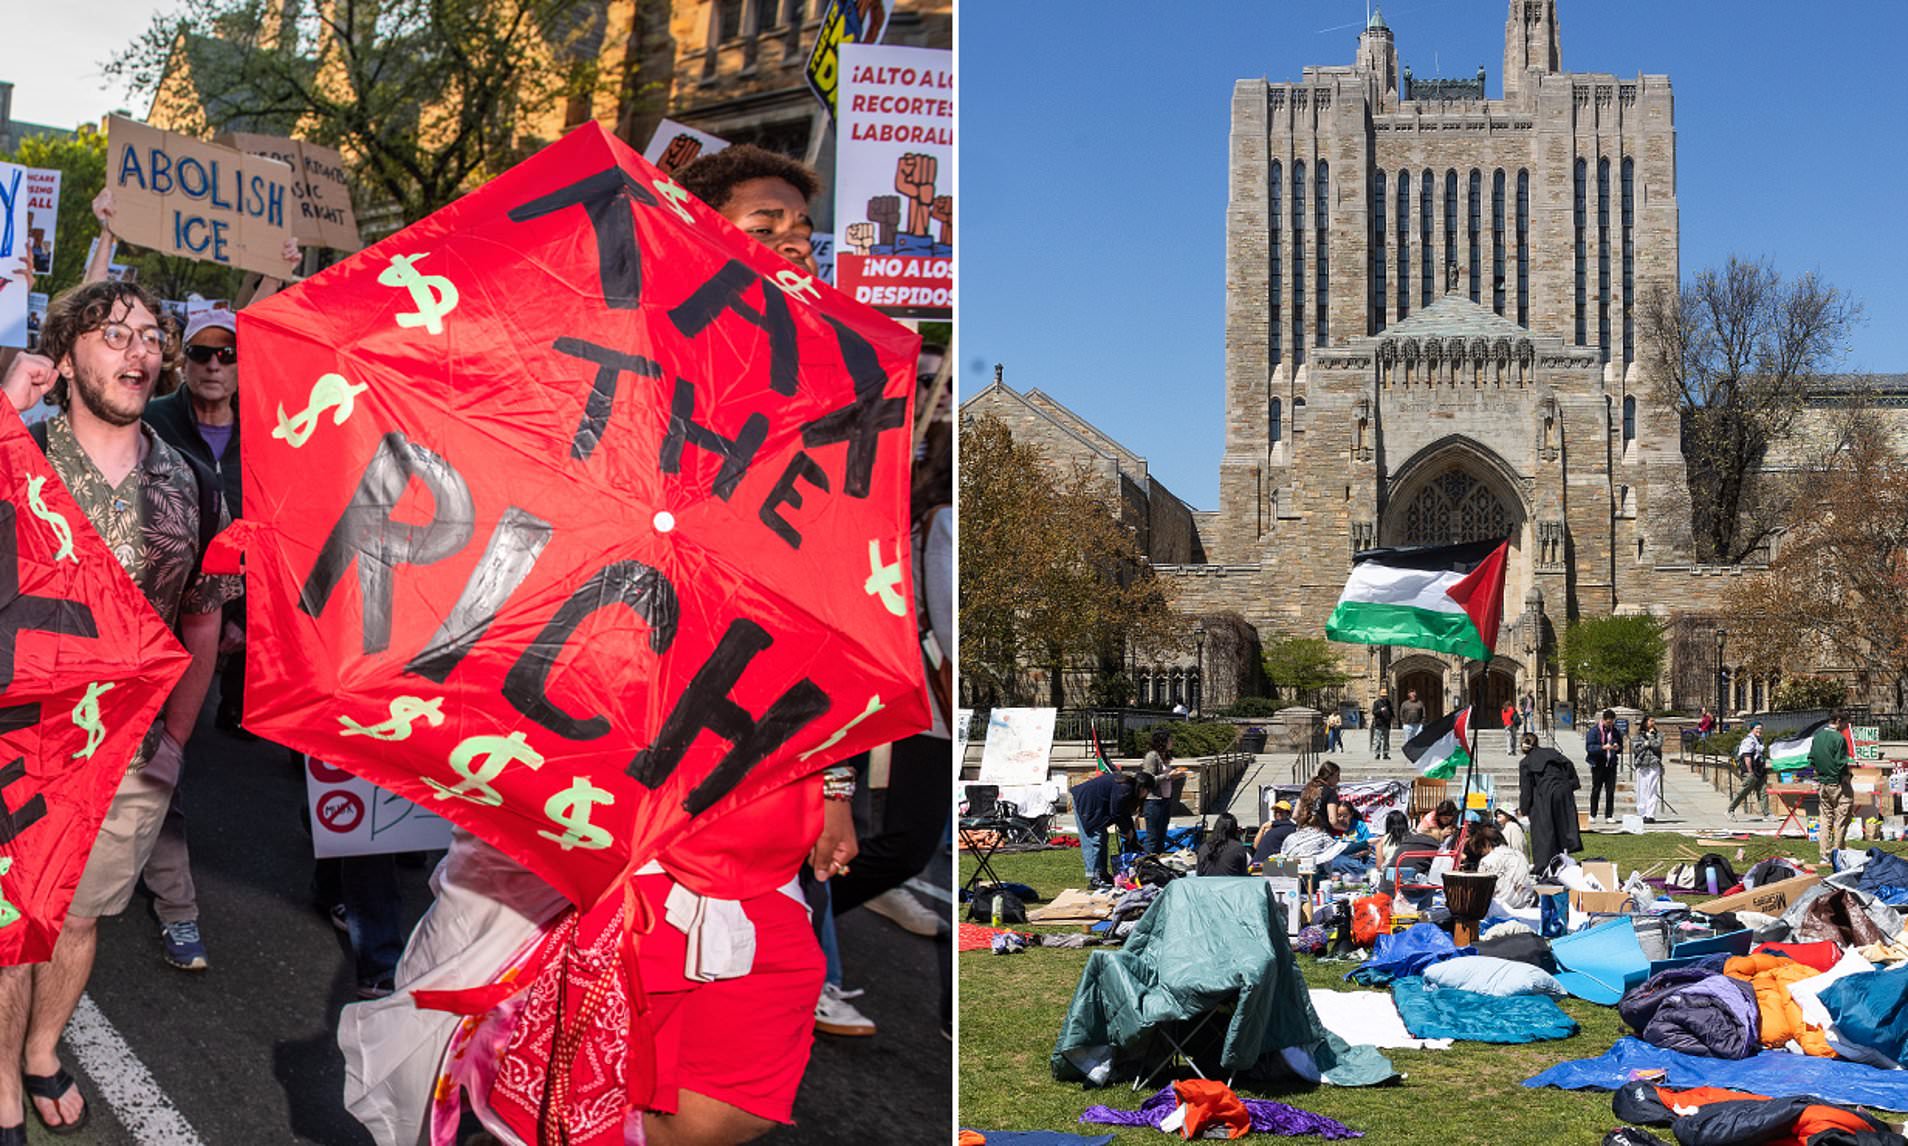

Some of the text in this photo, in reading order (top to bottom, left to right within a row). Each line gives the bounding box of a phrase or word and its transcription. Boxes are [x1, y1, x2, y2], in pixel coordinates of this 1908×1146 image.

[852, 65, 952, 89] ¡ALTO A L
[852, 122, 952, 146] LABORAL
[28, 196, 53, 209] ALL
[119, 144, 285, 228] ABOLISH
[174, 210, 230, 262] ICE
[862, 258, 903, 278] ¡NO
[904, 259, 921, 278] A
[507, 164, 908, 499] TAX
[552, 335, 830, 550] THE
[299, 431, 832, 818] RICH
